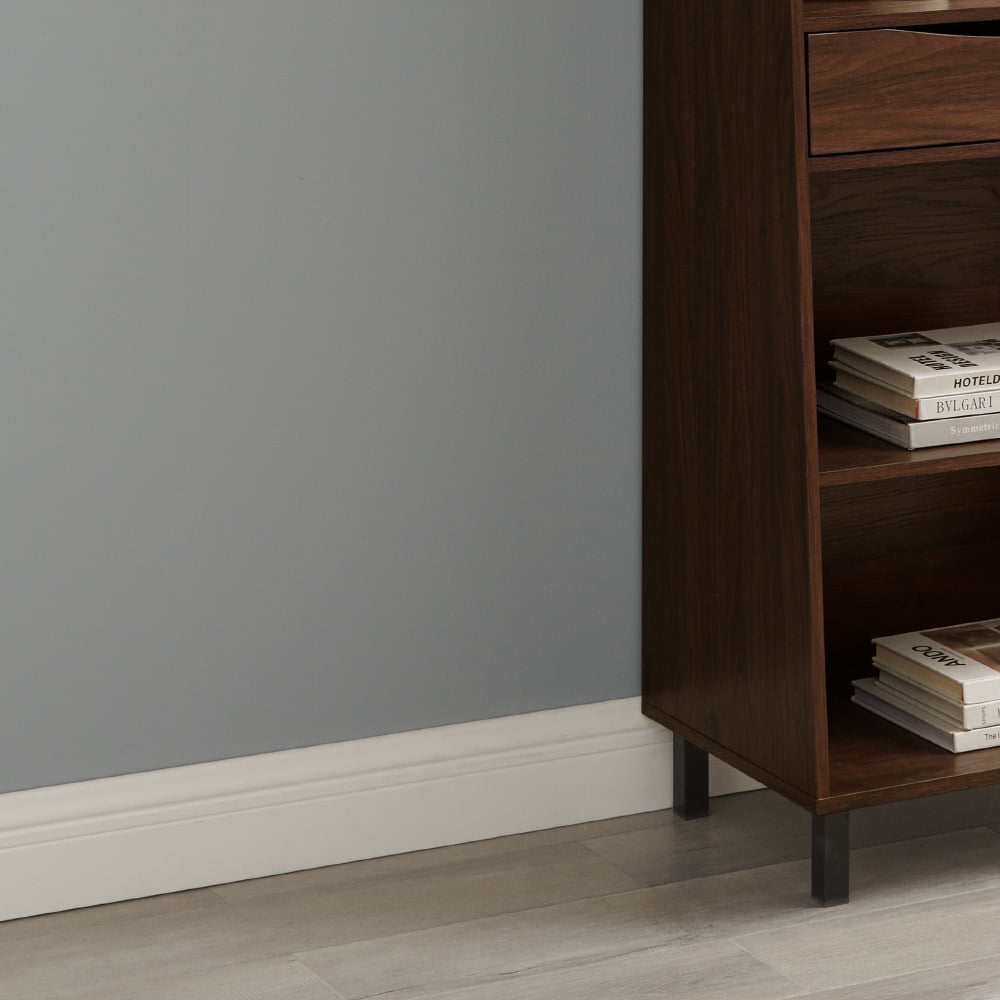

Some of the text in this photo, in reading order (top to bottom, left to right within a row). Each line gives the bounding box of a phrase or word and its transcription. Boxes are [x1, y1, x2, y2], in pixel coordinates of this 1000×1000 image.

[936, 396, 993, 414] BVLGARI
[911, 645, 967, 667] ANDO
[984, 733, 997, 741] The
